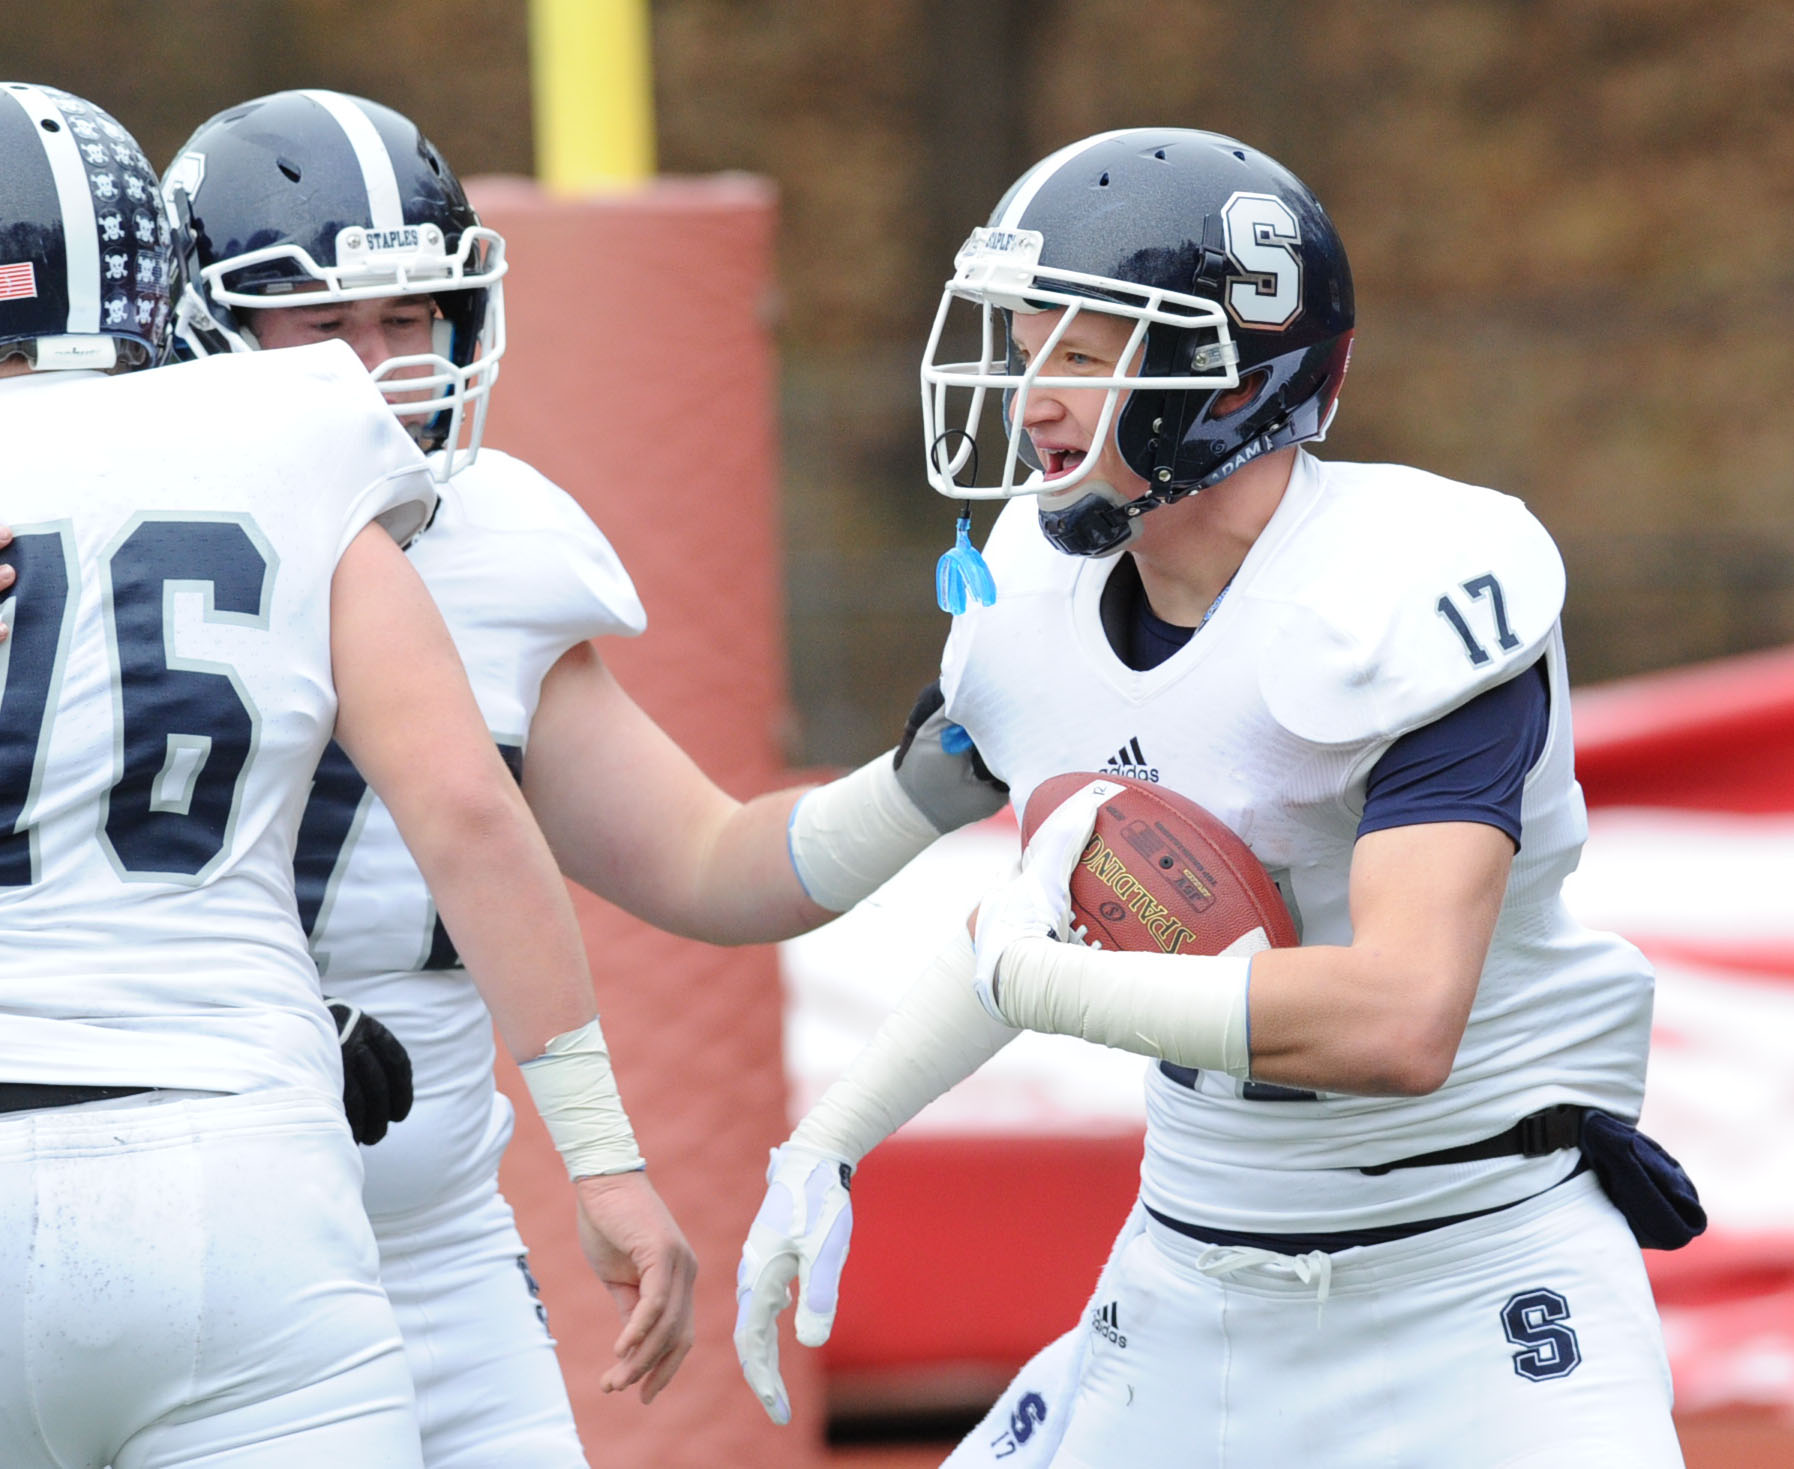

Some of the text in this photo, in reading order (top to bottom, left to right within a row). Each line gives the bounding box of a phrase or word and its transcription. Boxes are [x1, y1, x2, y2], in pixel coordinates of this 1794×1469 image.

[366, 230, 418, 250] STAPLES
[1221, 191, 1304, 332] S
[1436, 571, 1523, 669] 17
[1099, 764, 1159, 783] didas
[1080, 833, 1196, 953] SPALDING
[1499, 1286, 1582, 1383] S
[990, 1430, 1016, 1460] 17
[1010, 1390, 1048, 1445] S
